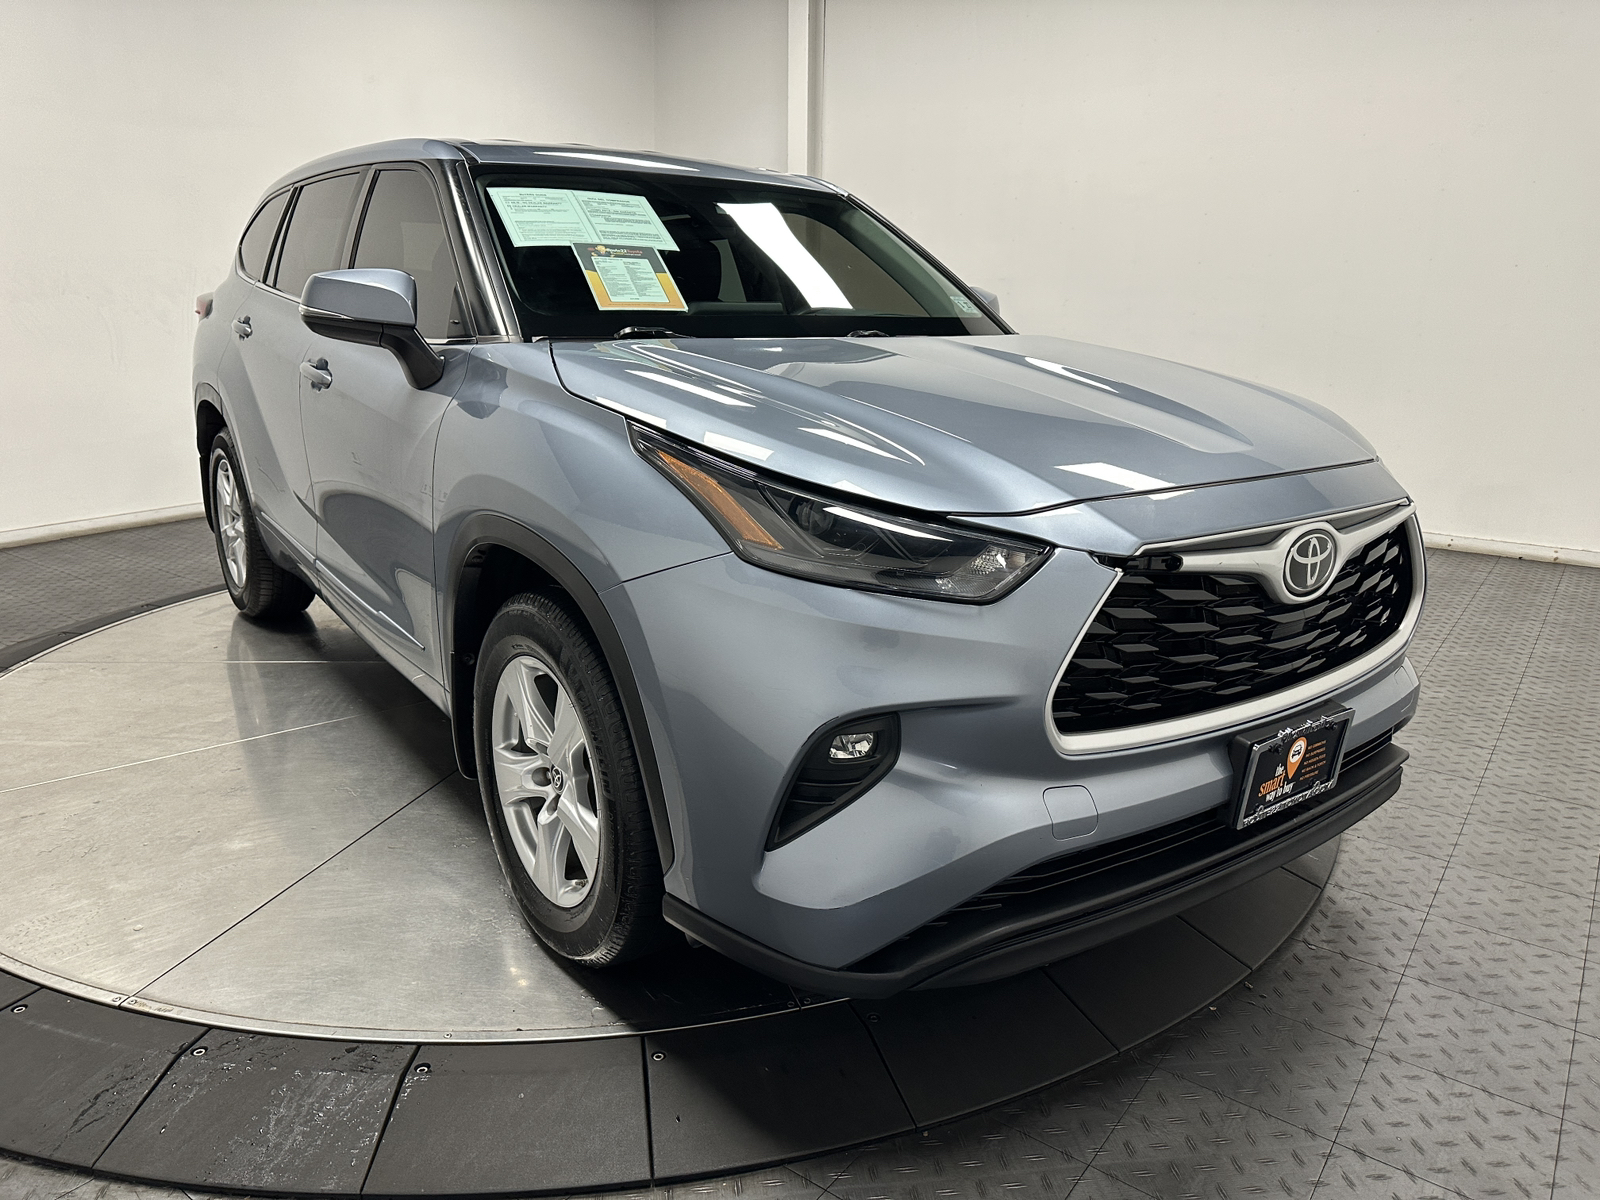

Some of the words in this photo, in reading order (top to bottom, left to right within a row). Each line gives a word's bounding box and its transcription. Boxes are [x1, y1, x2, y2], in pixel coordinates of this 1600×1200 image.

[1275, 763, 1285, 777] the
[1258, 770, 1286, 797] smart
[1265, 792, 1276, 802] way
[1276, 788, 1282, 799] to
[1282, 781, 1296, 795] buy
